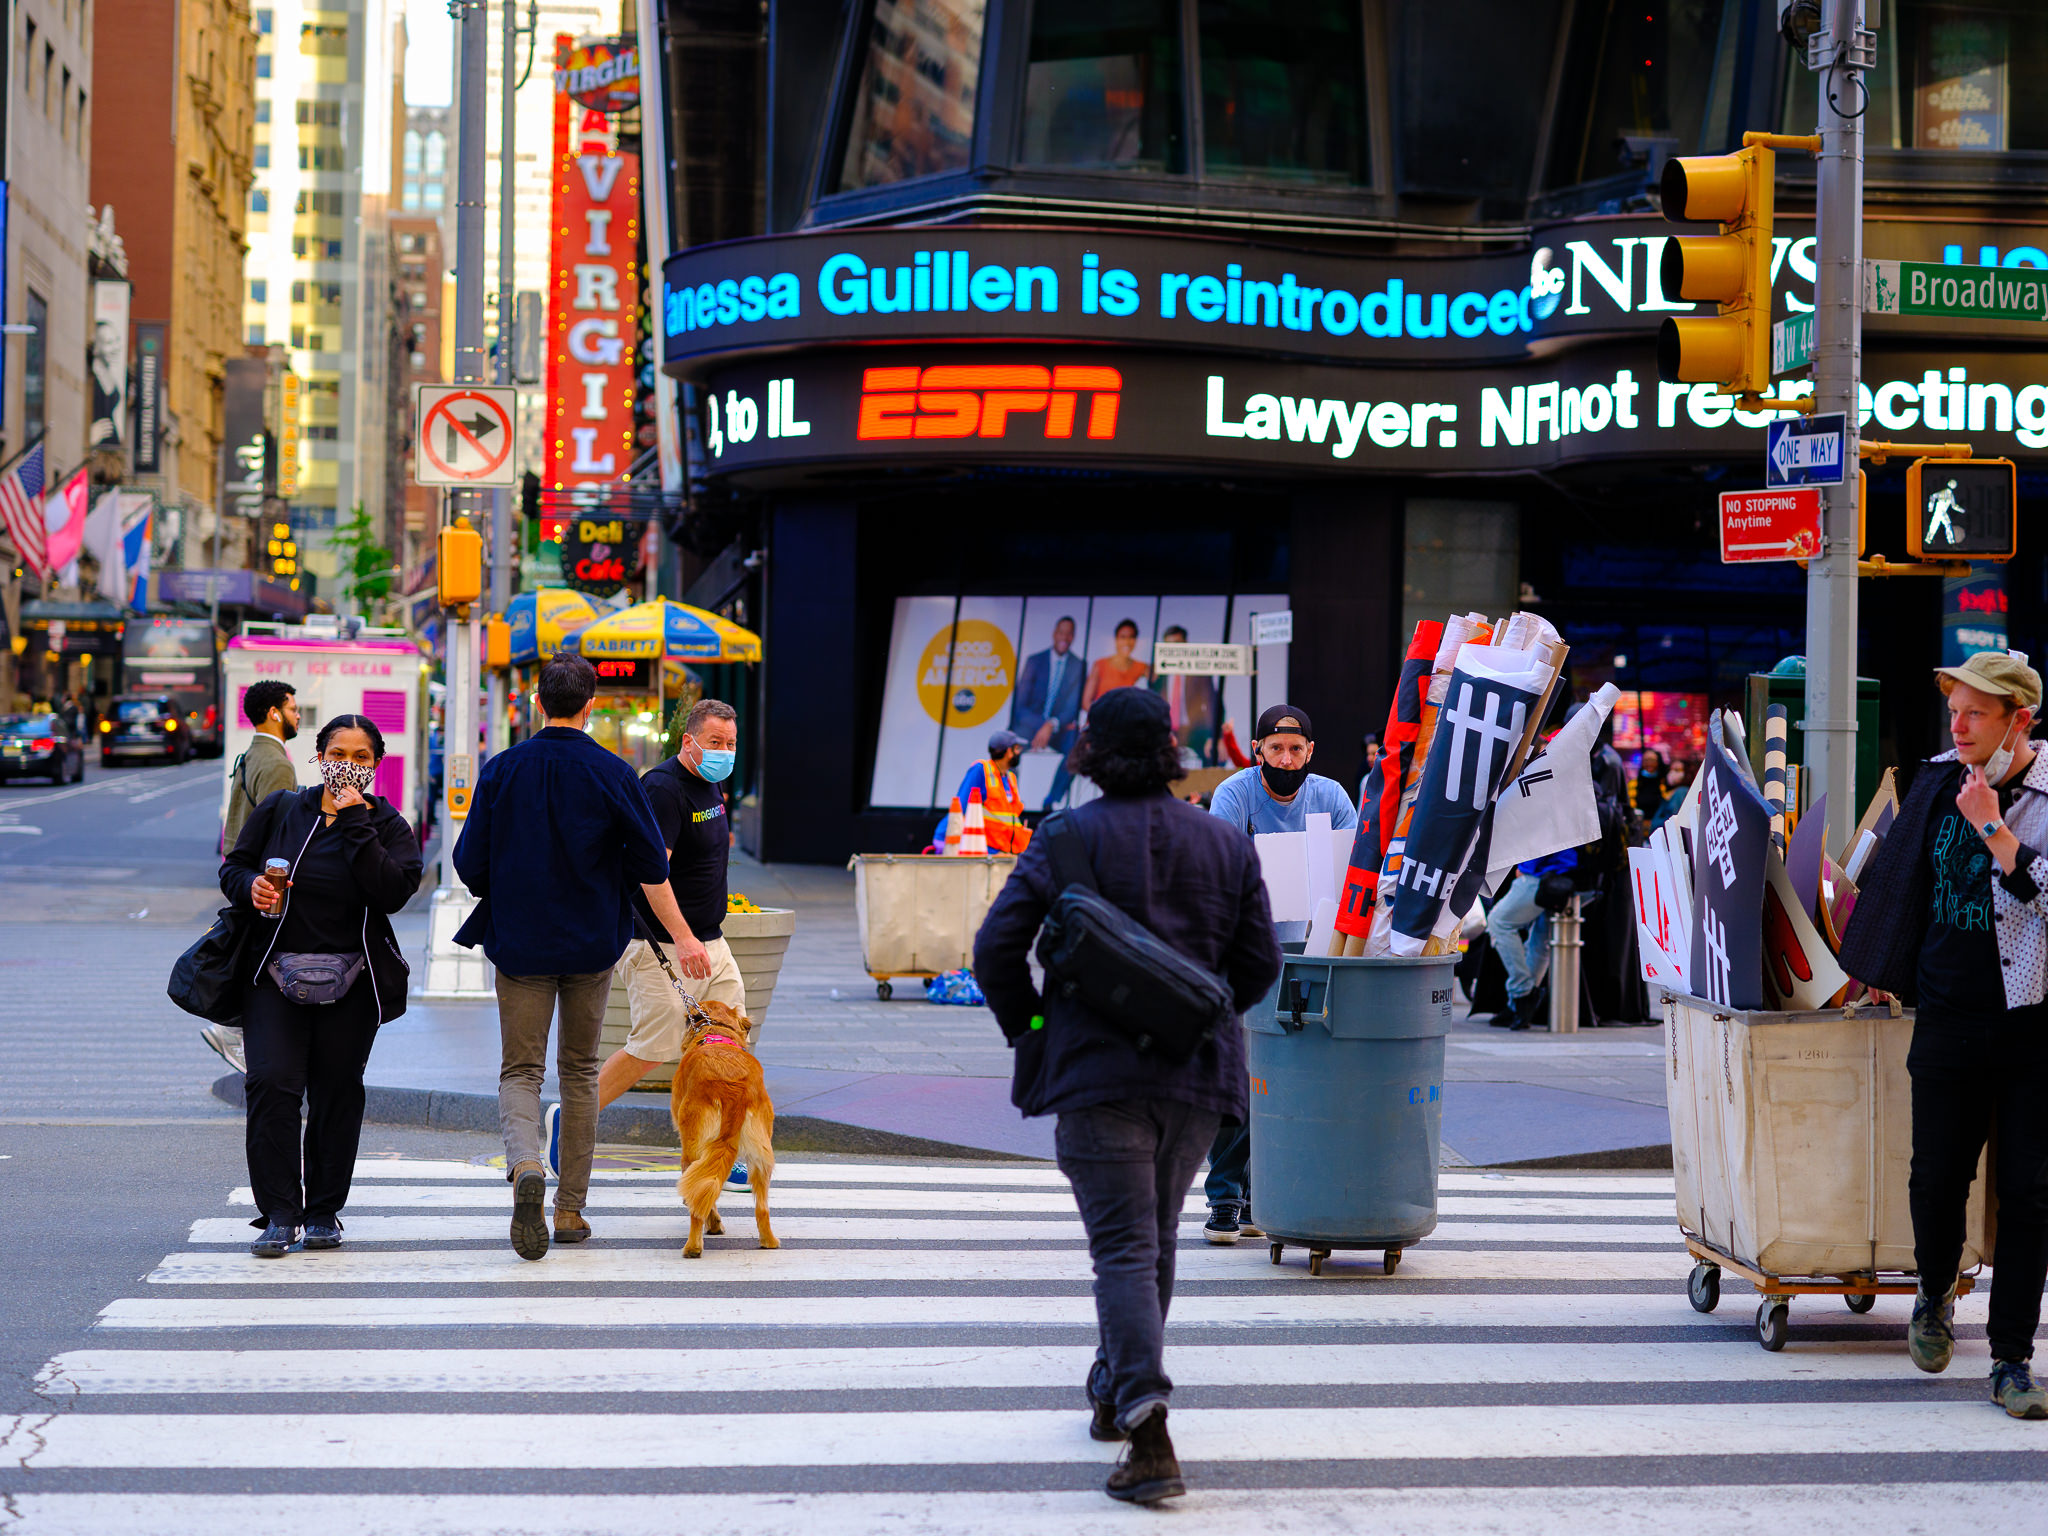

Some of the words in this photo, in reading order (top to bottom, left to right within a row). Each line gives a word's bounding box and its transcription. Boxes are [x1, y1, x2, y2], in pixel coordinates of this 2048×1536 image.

[664, 271, 801, 338] anessa
[818, 250, 1058, 316] Guillen
[1082, 253, 1140, 317] is
[1911, 271, 2048, 321] Broadway
[1786, 325, 1796, 363] W
[1800, 319, 1815, 358] 44
[725, 389, 759, 444] to
[767, 378, 811, 439] IL
[856, 365, 1123, 441] ESPN
[1206, 376, 1457, 459] Lawyer:
[1561, 369, 1640, 437] not
[1779, 439, 1800, 466] ONE
[1811, 436, 1834, 464] WAY
[1726, 500, 1741, 513] NO
[1745, 497, 1797, 513] STOPPING
[1727, 515, 1772, 531] Anytime
[579, 519, 623, 544] Deli
[575, 557, 625, 581] Café
[586, 639, 659, 653] SABRETT
[254, 660, 295, 675] SOFT
[307, 661, 331, 676] ICE
[340, 661, 392, 676] CREAM
